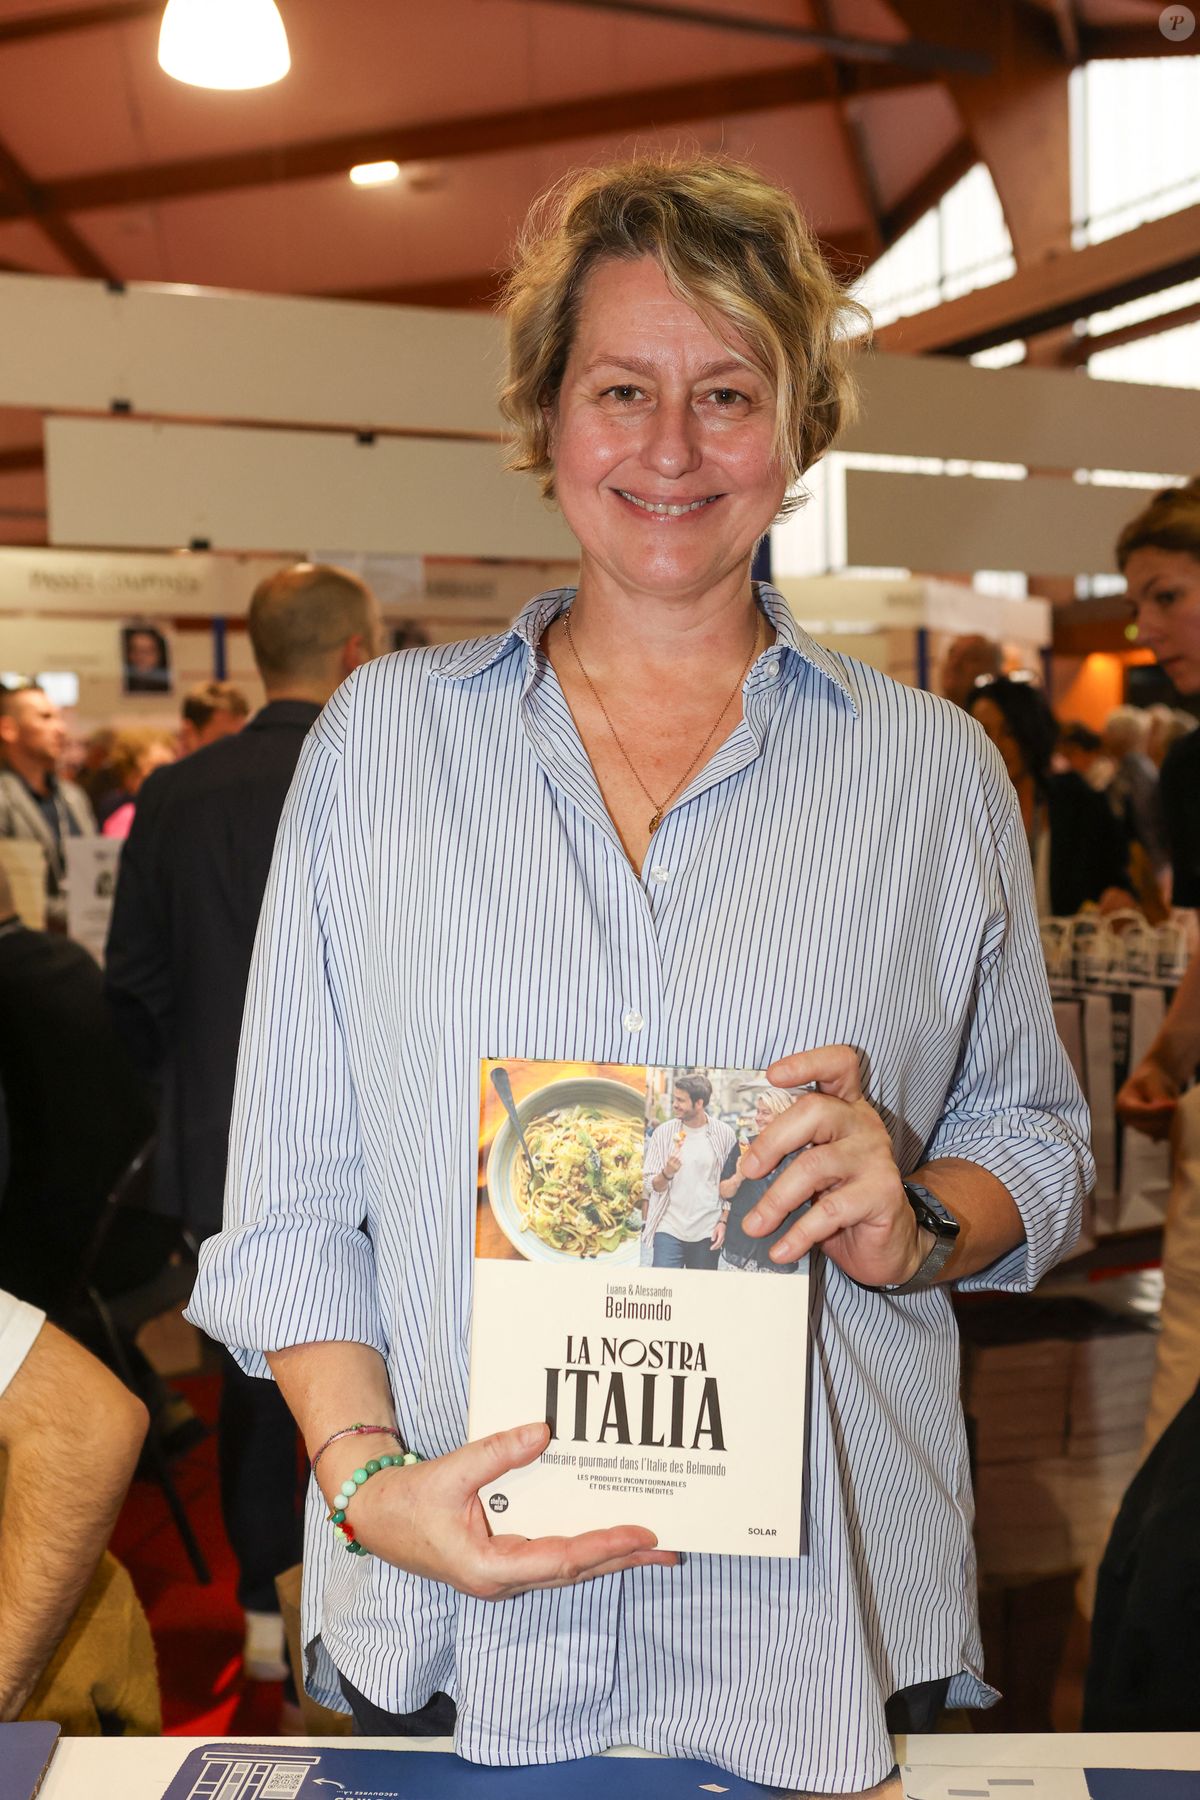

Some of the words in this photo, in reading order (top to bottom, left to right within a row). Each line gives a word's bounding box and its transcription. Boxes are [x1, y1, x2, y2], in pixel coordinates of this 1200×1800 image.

[606, 1283, 626, 1295] Luana
[628, 1284, 634, 1296] &
[635, 1284, 672, 1298] Alessandro
[605, 1296, 672, 1321] Belmondo
[566, 1335, 591, 1365] LA
[600, 1337, 708, 1372] NOSTRA
[544, 1367, 728, 1452] ITALIA
[578, 1455, 618, 1469] gourmand
[619, 1456, 639, 1470] dans
[641, 1457, 668, 1473] l'Italie
[669, 1460, 684, 1474] des
[686, 1460, 726, 1476] Belmondo
[590, 1475, 622, 1483] PRODUITS
[623, 1477, 687, 1488] INCONTOURNABLES
[611, 1485, 644, 1494] RECETTES
[748, 1527, 777, 1537] SOLAR
